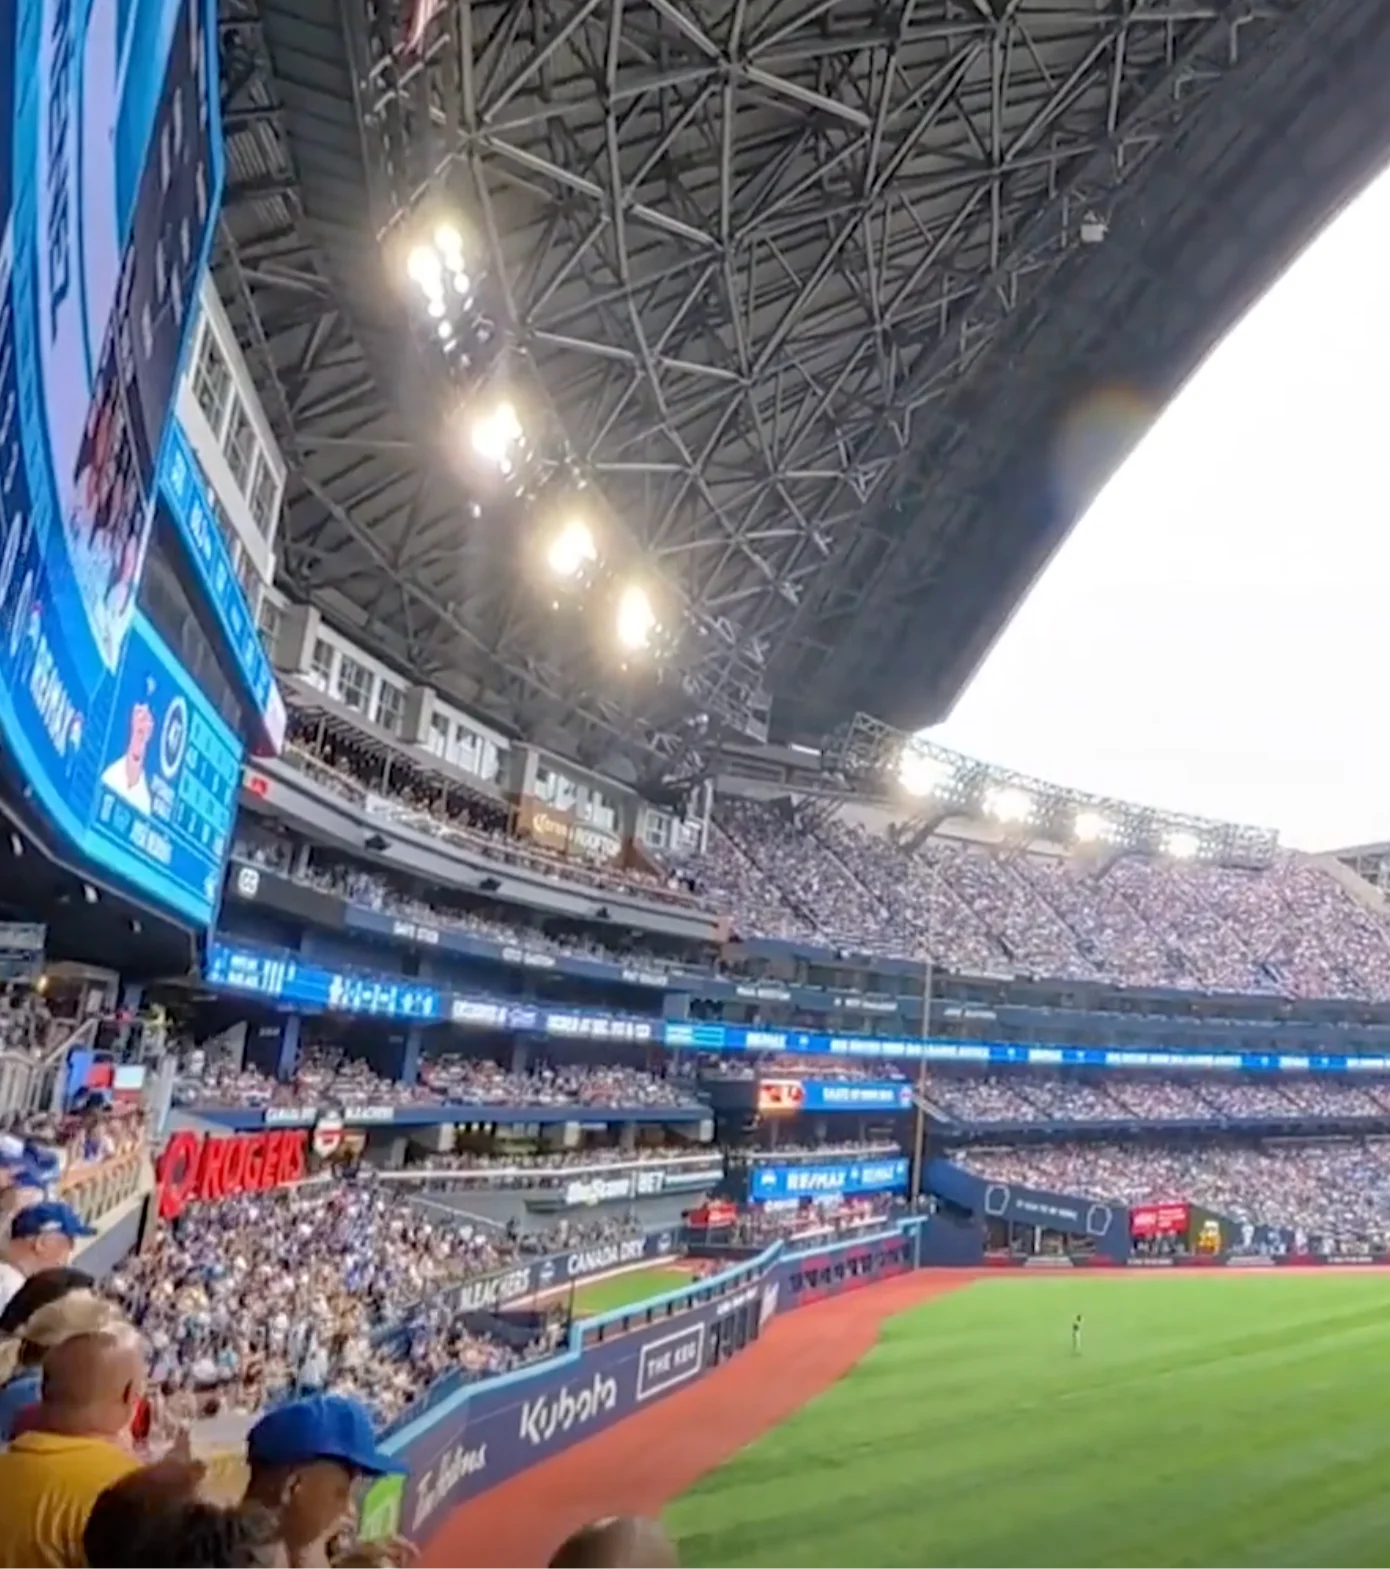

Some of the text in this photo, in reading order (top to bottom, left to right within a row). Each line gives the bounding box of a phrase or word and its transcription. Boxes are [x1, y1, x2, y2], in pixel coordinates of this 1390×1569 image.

[201, 1130, 308, 1201] ROGERS
[638, 1169, 665, 1194] BET
[787, 1171, 846, 1191] RE/MAX
[567, 1244, 617, 1275] CANADA
[620, 1237, 646, 1262] DRY
[647, 1340, 697, 1378] THE KEG
[519, 1371, 618, 1445] Kubota
